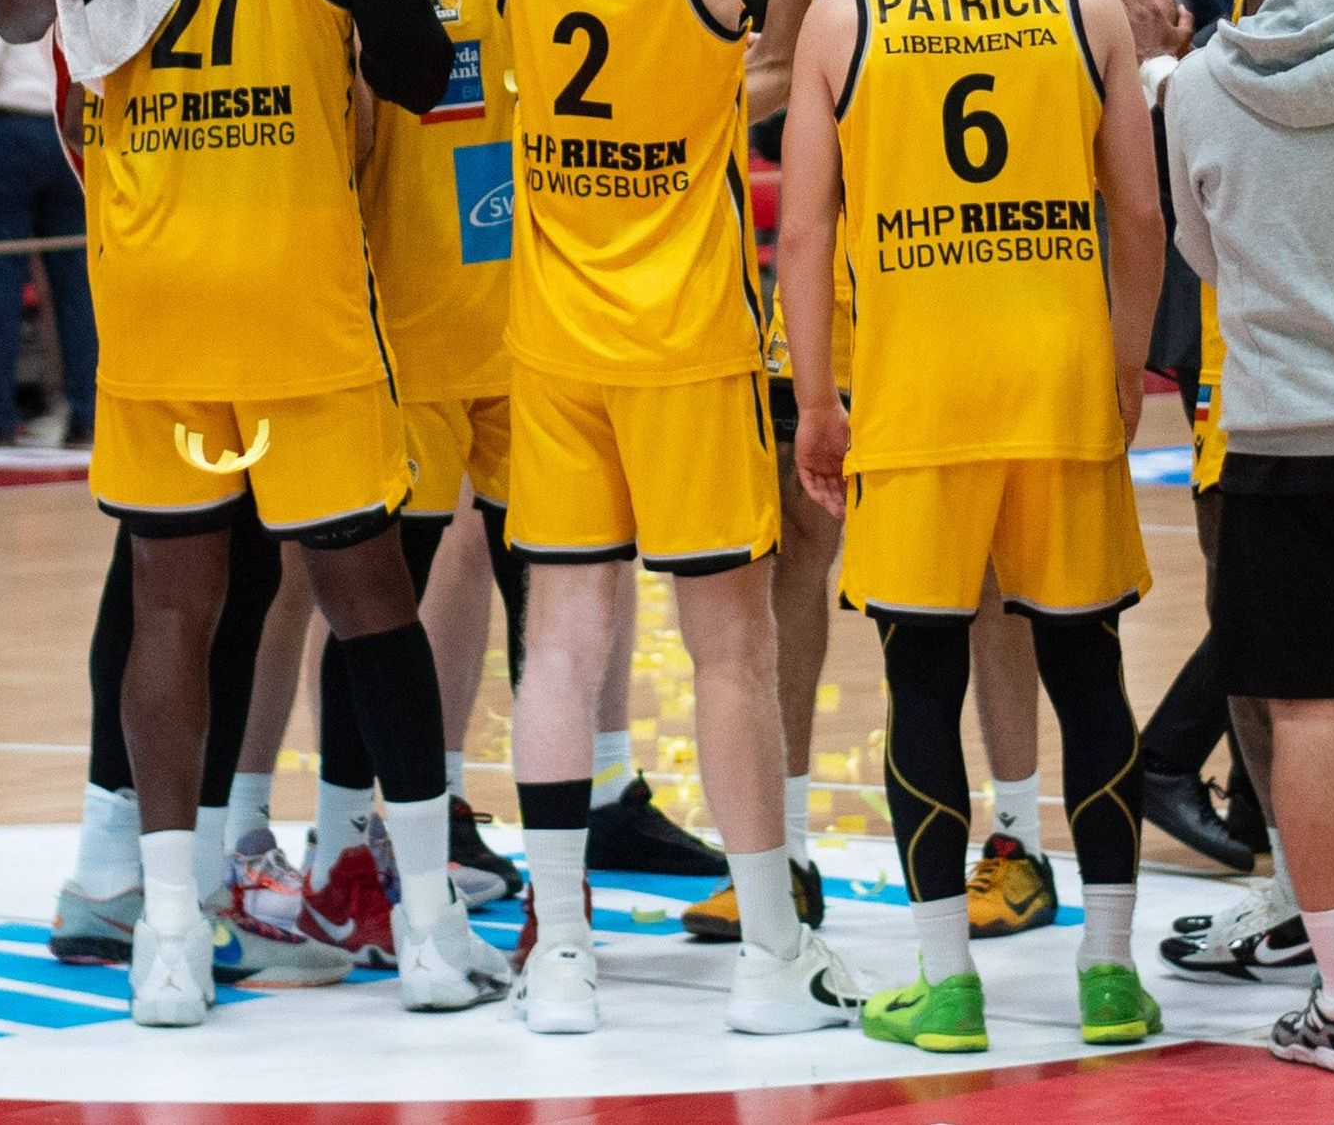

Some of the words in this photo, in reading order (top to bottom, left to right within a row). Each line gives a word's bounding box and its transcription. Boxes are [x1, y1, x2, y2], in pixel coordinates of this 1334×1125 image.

[883, 27, 1058, 55] LIBERMENTA
[552, 11, 613, 121] 2
[181, 85, 292, 122] RIESEN
[942, 72, 1009, 184] 6
[522, 132, 557, 164] HP
[561, 137, 687, 172] RIESEN
[527, 166, 690, 200] DWIGSBURG
[876, 205, 955, 243] MHP
[960, 199, 1091, 234] RIESEN
[878, 236, 1095, 273] LUDWIGSBURG
